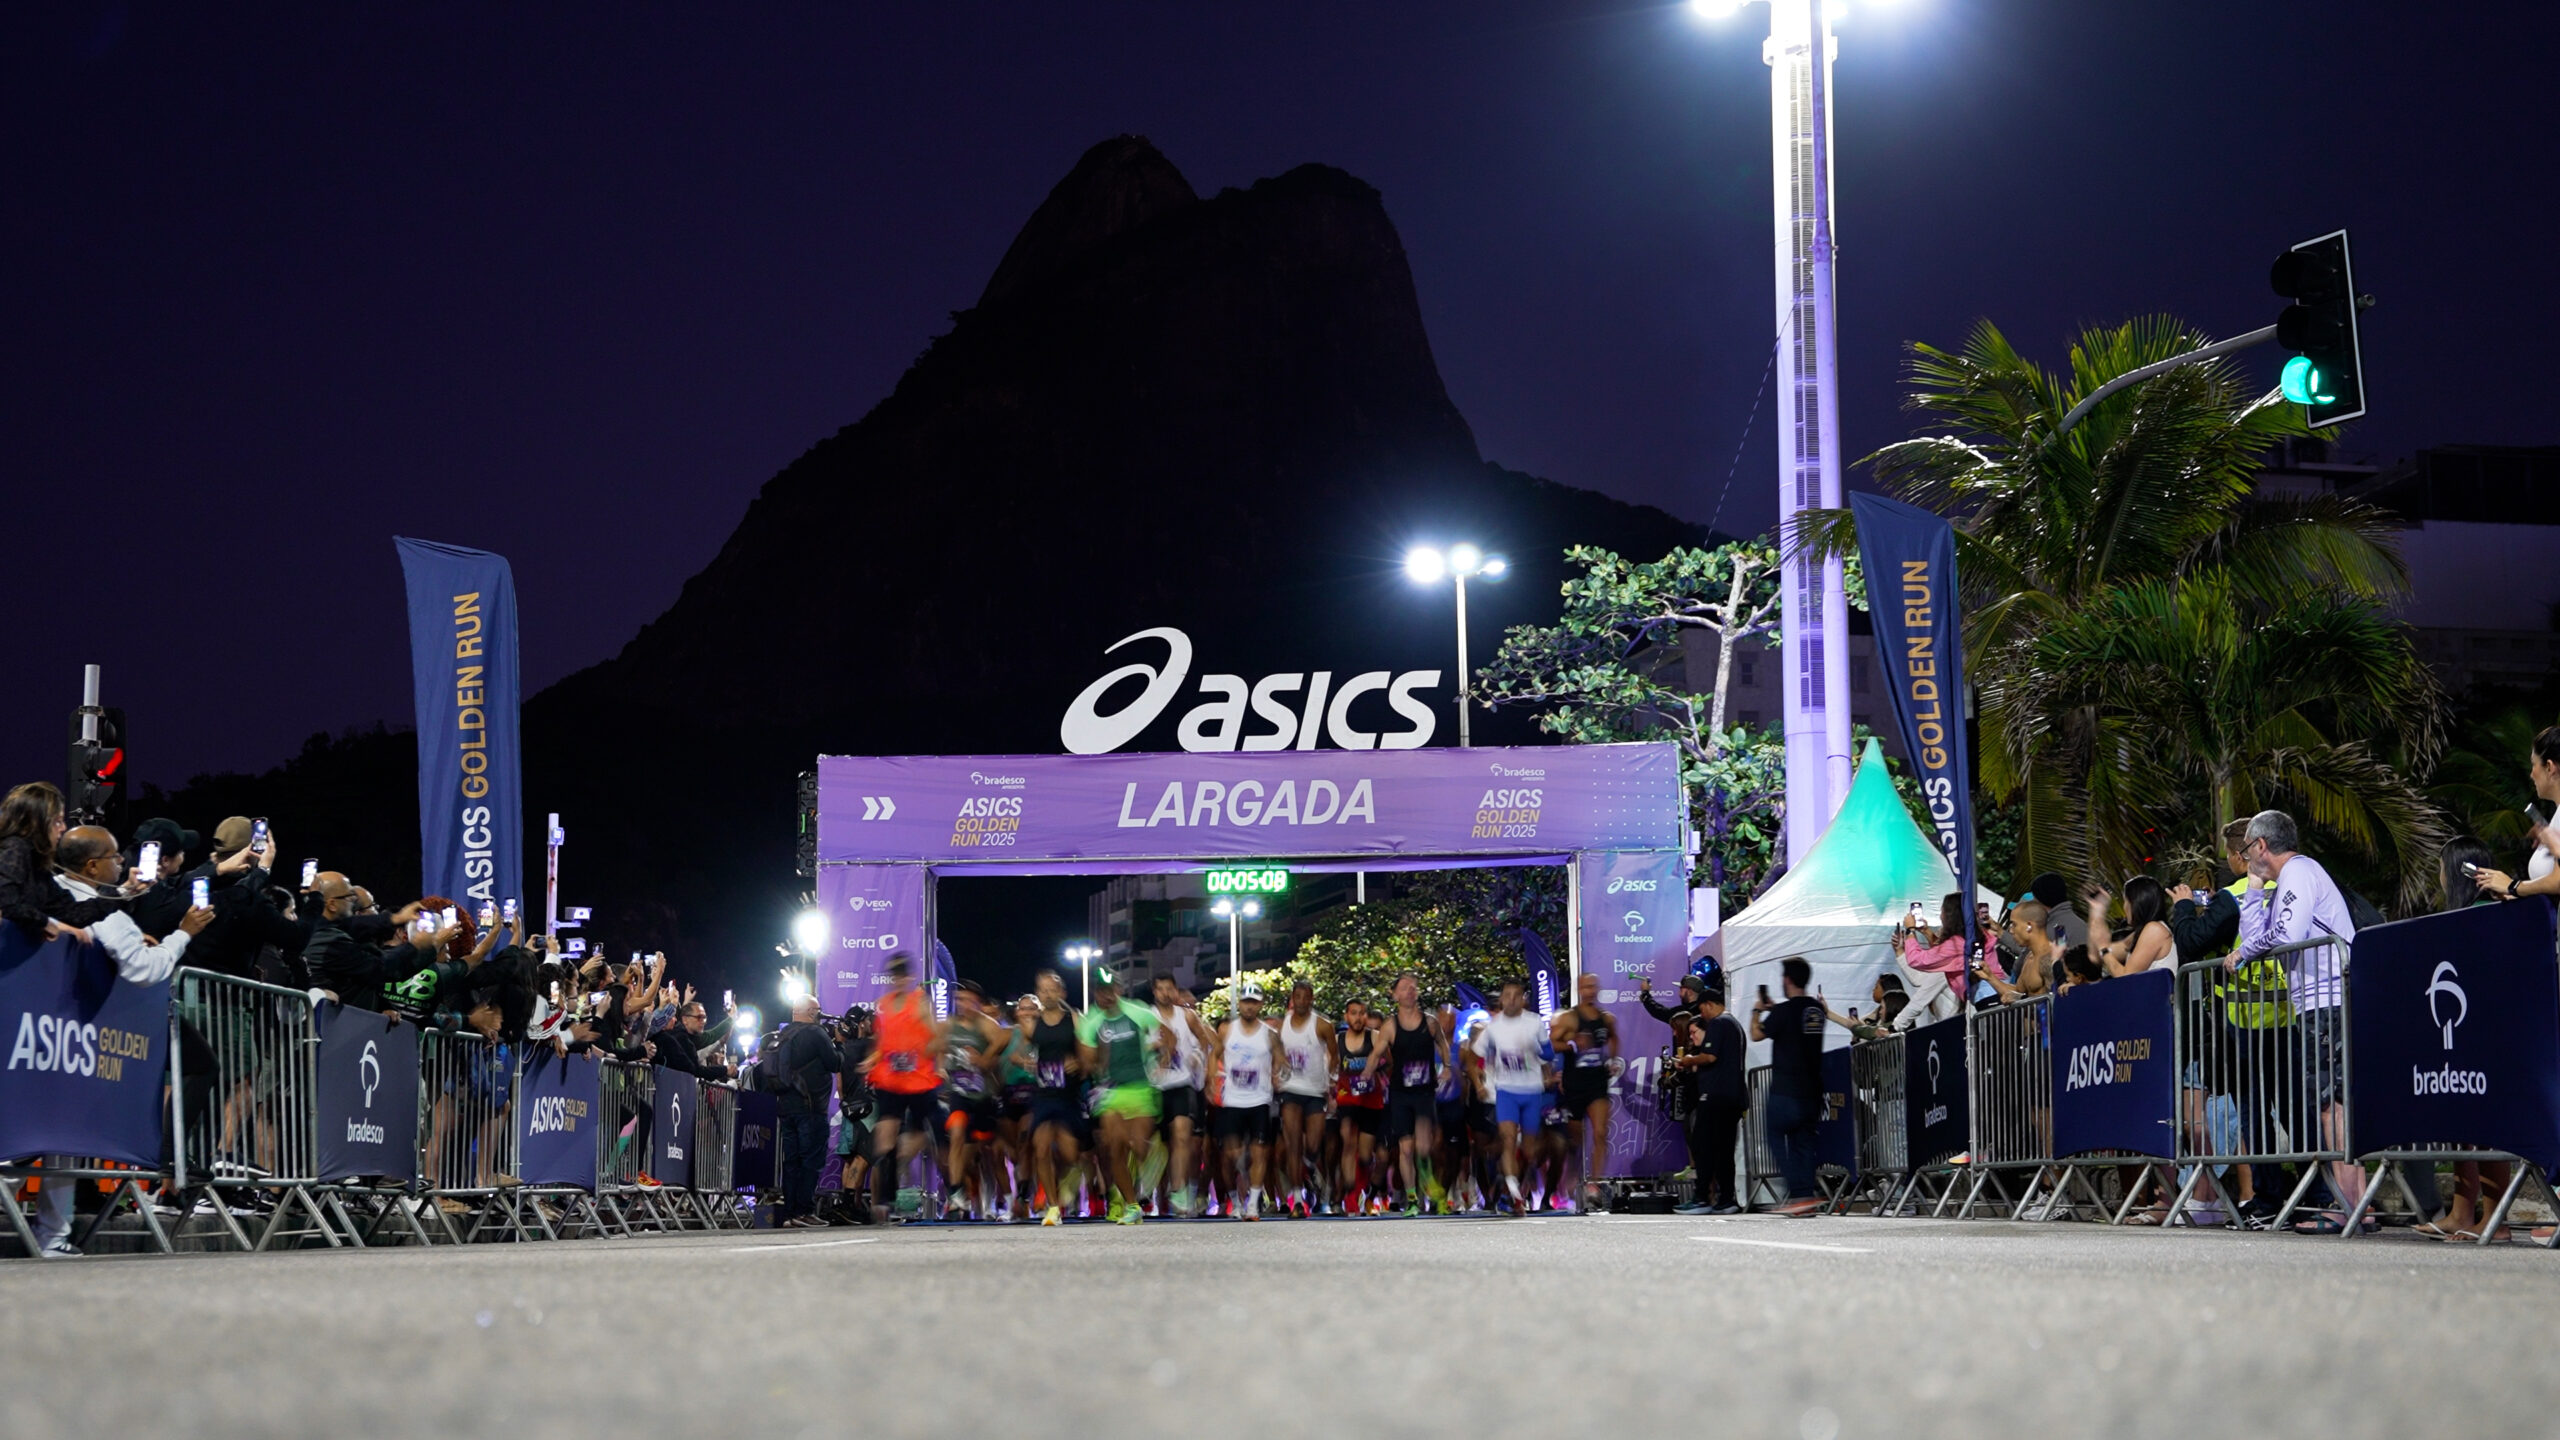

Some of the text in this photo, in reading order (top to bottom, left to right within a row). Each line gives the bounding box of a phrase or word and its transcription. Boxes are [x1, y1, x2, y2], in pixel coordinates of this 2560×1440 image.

[1902, 560, 1933, 628] RUN
[1177, 669, 1442, 753] asics
[1907, 635, 1948, 770] GOLDEN
[453, 591, 495, 901] ASICS GOLDEN RUN
[984, 775, 1026, 785] bradesco
[1504, 768, 1546, 777] bradesco
[958, 796, 1023, 817] ASICS
[1117, 778, 1376, 828] LARGADA
[1479, 788, 1544, 809] ASICS
[955, 817, 1020, 832] GOLDEN
[1475, 808, 1541, 824] GOLDEN
[950, 832, 1017, 847] RUN 2025
[1471, 824, 1537, 838] RUN 2025
[1623, 880, 1657, 891] asics
[865, 900, 892, 908] VEGA
[842, 936, 876, 949] terra
[1614, 934, 1654, 943] bradesco
[1613, 960, 1656, 973] Bioré
[1620, 990, 1674, 998] ATLESMO
[7, 1011, 98, 1078] ASICS
[99, 1026, 150, 1062] GOLDEN
[2116, 1037, 2151, 1061] GOLDEN
[96, 1054, 123, 1082] RUN
[2066, 1040, 2116, 1093] ASICS
[2114, 1063, 2132, 1083] RUN
[2412, 1061, 2487, 1096] bradesco
[529, 1096, 566, 1137] ASICS
[565, 1098, 588, 1119] GOLDEN
[347, 1116, 384, 1145] bradesco
[563, 1115, 576, 1133] RUN
[741, 1123, 761, 1152] ASICS
